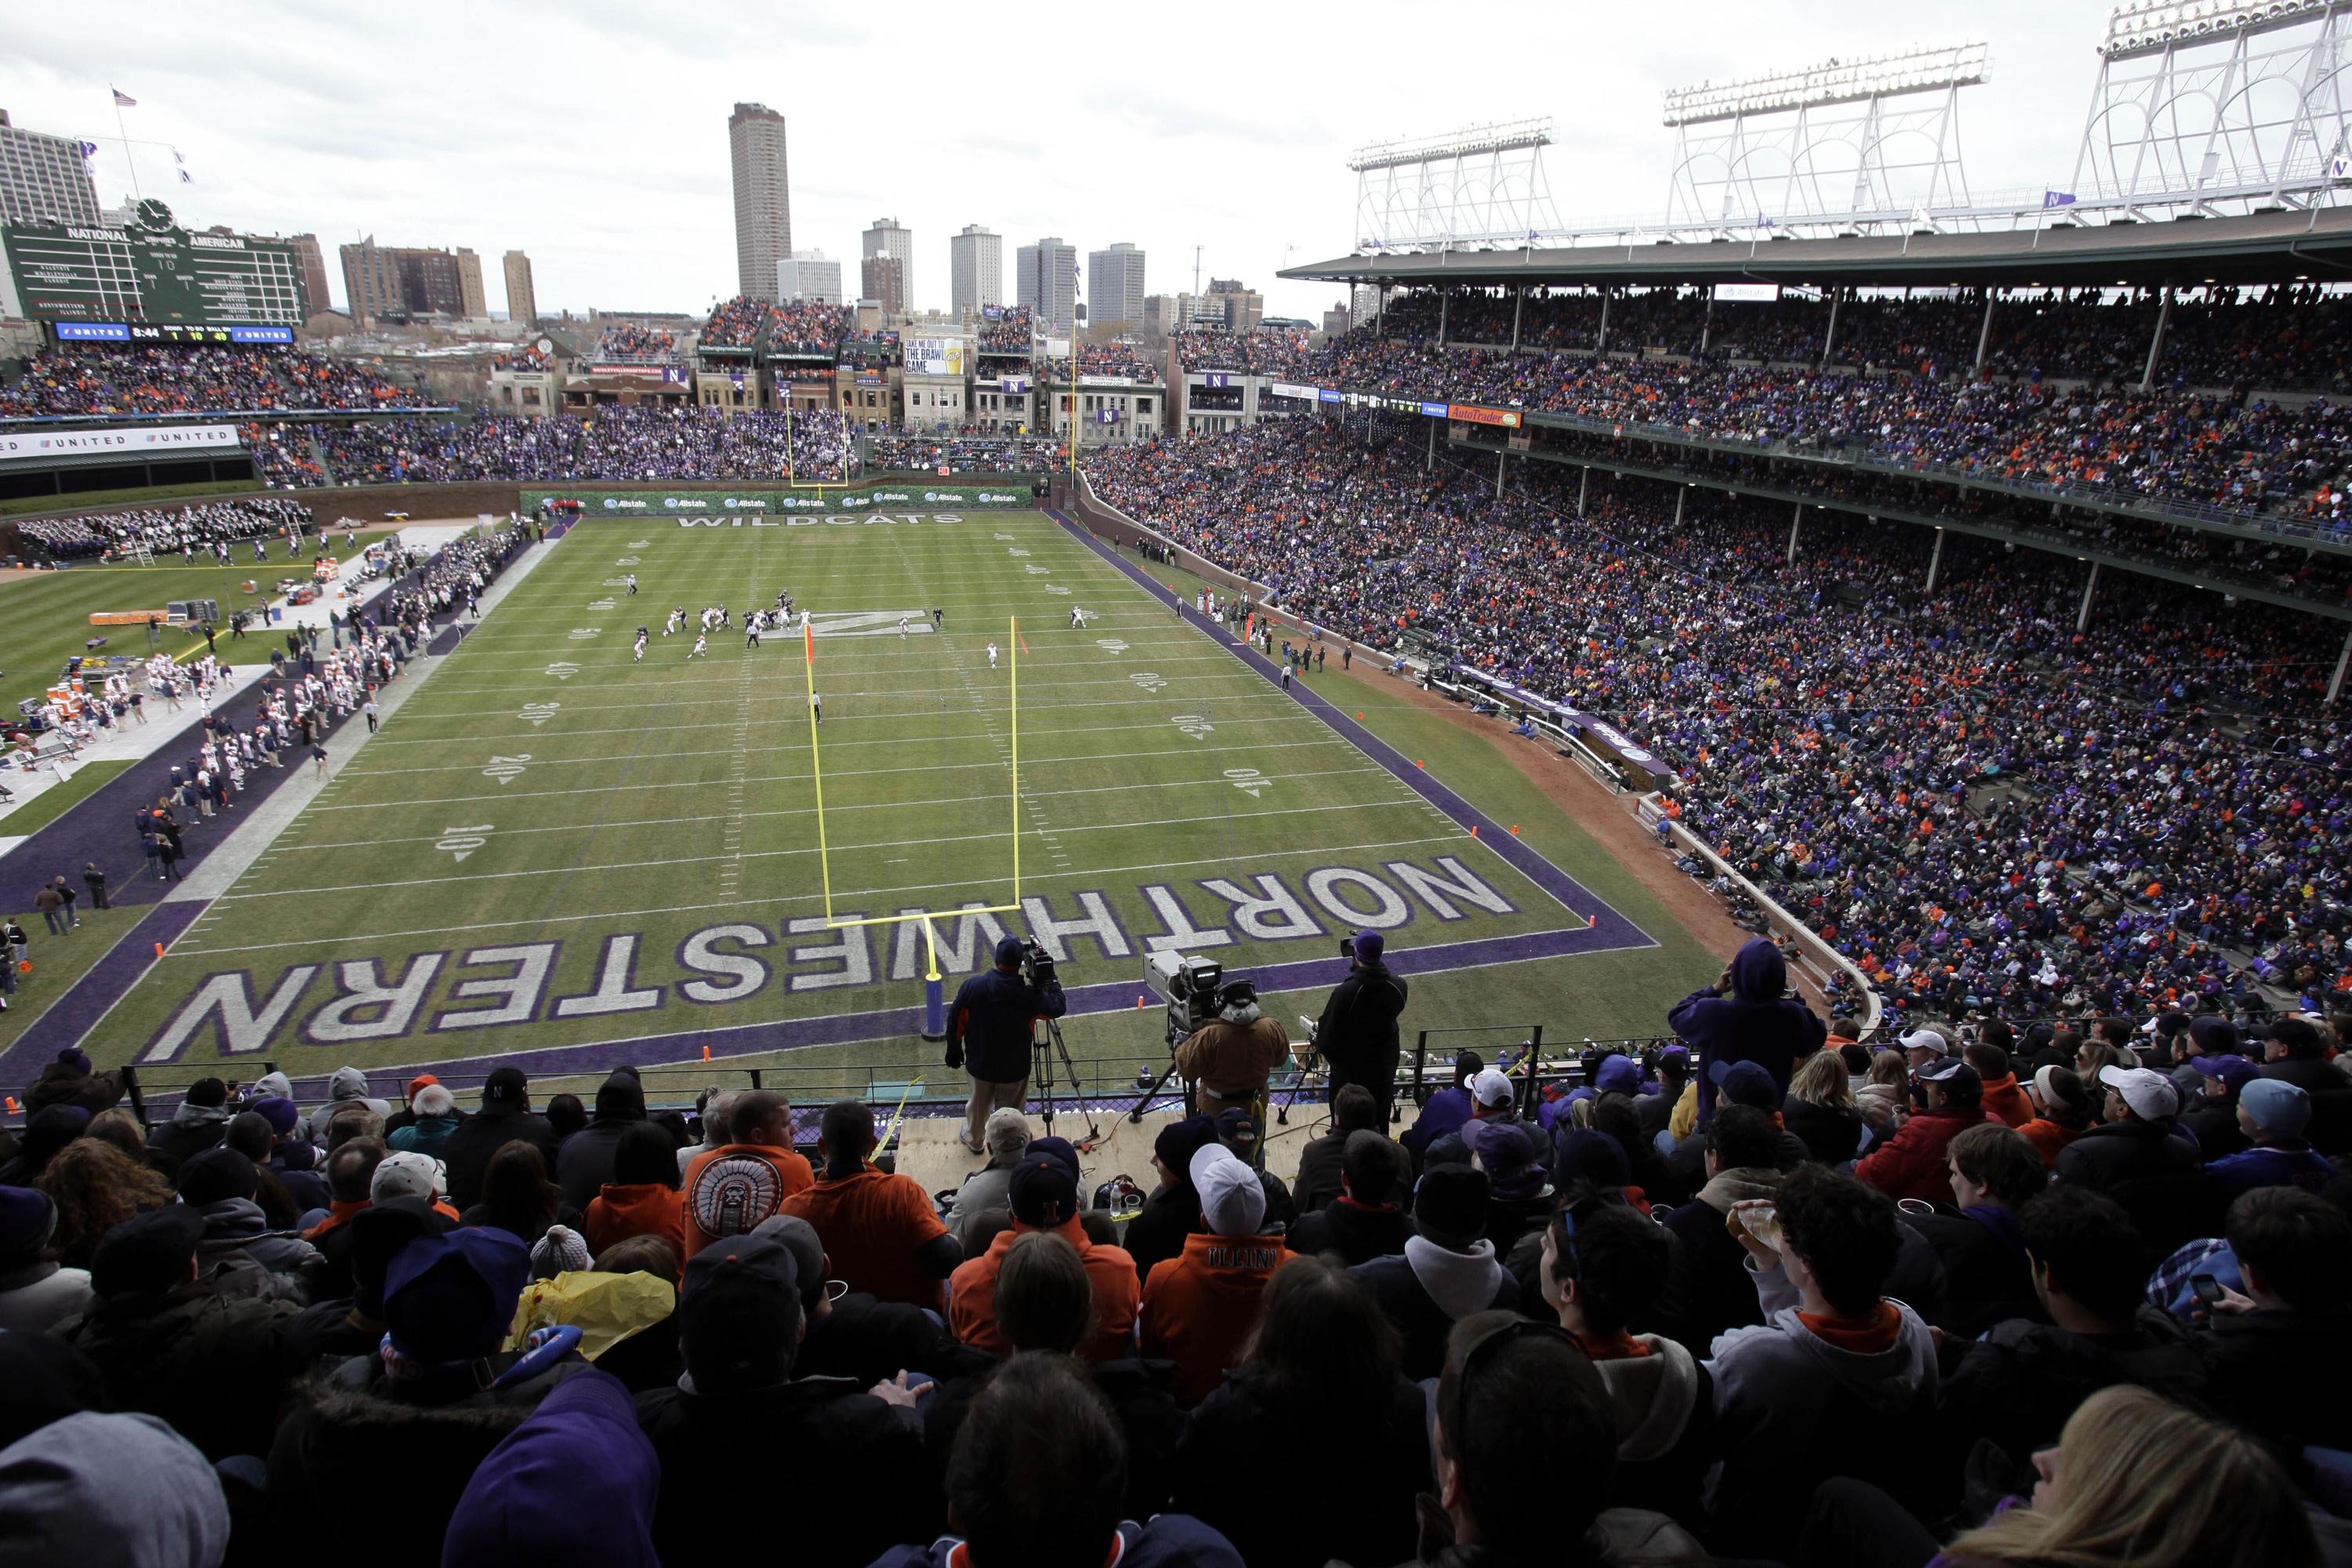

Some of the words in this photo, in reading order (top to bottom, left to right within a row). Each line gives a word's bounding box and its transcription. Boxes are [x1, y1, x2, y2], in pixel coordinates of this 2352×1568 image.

[67, 227, 131, 242] NATIONAL
[190, 236, 245, 249] AMERICAN
[158, 260, 175, 270] 10
[74, 328, 124, 337] UNITED
[132, 327, 159, 338] 8:44
[172, 332, 179, 340] 1
[190, 332, 203, 341] 10
[214, 332, 227, 341] 49
[906, 339, 917, 348] TAKE
[918, 339, 926, 348] ME
[927, 339, 938, 348] OUT
[938, 339, 945, 348] TO
[906, 348, 920, 360] THE
[921, 348, 945, 361] BRAWL
[906, 361, 930, 373] GAME.
[670, 369, 678, 382] N
[1213, 375, 1221, 387] N
[1010, 381, 1018, 393] N
[1104, 411, 1112, 423] N
[1453, 407, 1503, 423] AutoTrader
[56, 435, 126, 448] UNITED
[161, 430, 227, 443] UNITED
[618, 499, 647, 508] Allstate
[677, 499, 706, 508] Allstate
[737, 499, 766, 508] Allstate
[797, 499, 825, 507] Allstate
[937, 493, 963, 502] Allstate
[991, 494, 1016, 503] Allstate
[677, 514, 965, 527] WILDCATS
[1129, 672, 1167, 688] 30
[517, 702, 561, 719] 30
[1171, 714, 1216, 732] 20
[1592, 721, 1637, 750] Allstate
[481, 753, 532, 776] 20
[1222, 768, 1273, 788] 10
[434, 823, 495, 851] 10
[143, 855, 1519, 1063] NORTHWESTERN
[493, 1085, 503, 1098] N
[1207, 1247, 1278, 1269] ILLINI
